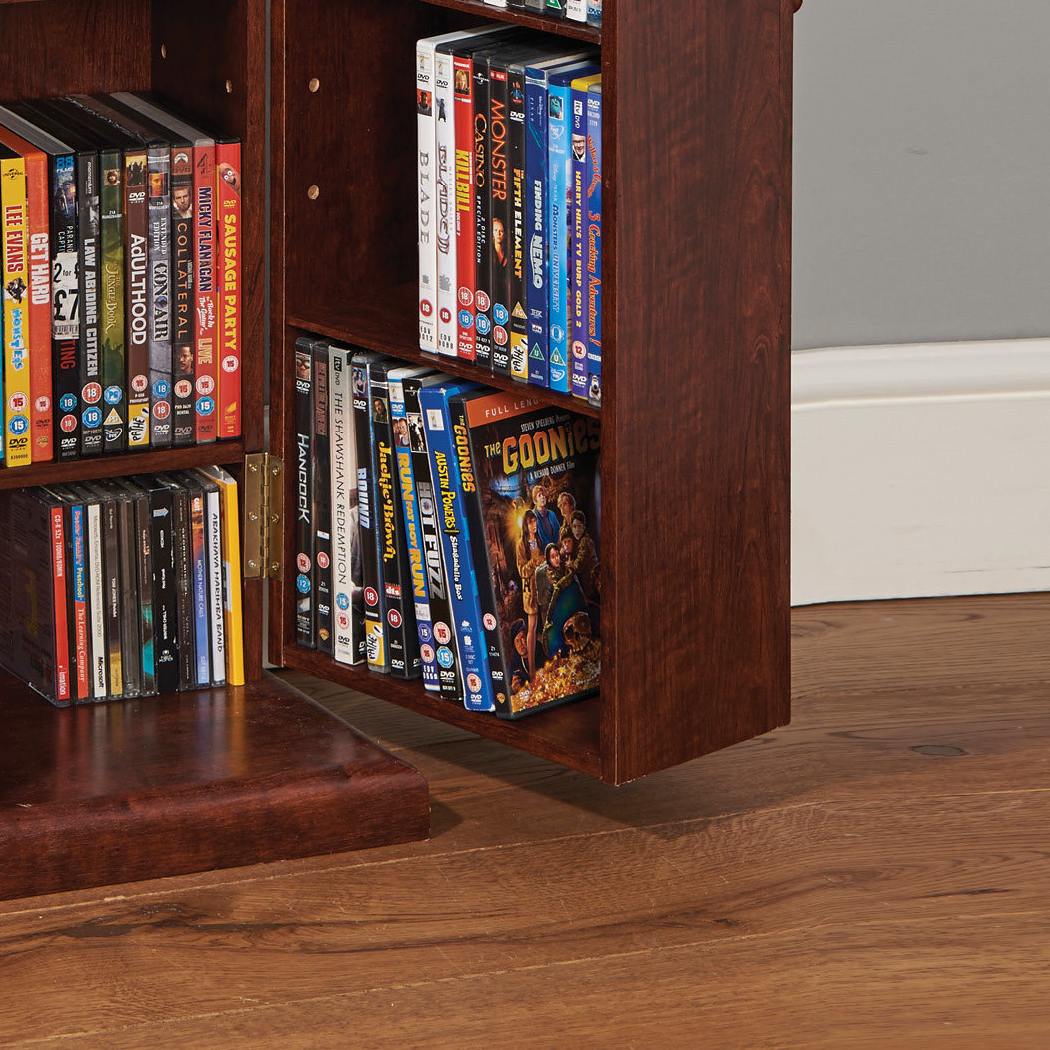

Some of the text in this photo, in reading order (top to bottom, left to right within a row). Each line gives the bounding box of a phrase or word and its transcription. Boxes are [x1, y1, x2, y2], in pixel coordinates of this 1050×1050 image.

[56, 156, 74, 168] 88
[456, 149, 471, 213] KILL BILL
[474, 113, 487, 189] CASINO
[491, 98, 507, 201] MONSTER
[419, 151, 430, 245] BLADE
[513, 168, 522, 279] FIFTH ELEMENT
[588, 210, 601, 222] 3
[5, 205, 24, 274] LEE EVANS
[198, 187, 212, 293] MICKY FLANAGAN
[533, 180, 543, 289] FINDING NEMO
[552, 202, 560, 313] MONSTERS UNIVERSITY
[575, 241, 582, 257] TV
[587, 223, 602, 277] Cracking
[30, 232, 50, 305] GET HARD
[54, 262, 71, 284] 2 for
[153, 262, 169, 341] CON AIR
[177, 222, 188, 339] COLLATERAL
[224, 214, 238, 351] SAUSAGE PARTY
[574, 259, 582, 287] BURP
[53, 289, 79, 321] £7
[84, 238, 99, 378] LAW ABIDING CITIZEN
[574, 289, 582, 318] GOLD
[198, 337, 213, 365] LIVE
[484, 407, 510, 418] FULL
[520, 415, 555, 434] STEVEN SPIELBERG
[297, 432, 311, 525] HANCOCK
[334, 392, 347, 585] THE SHAWSHANK REDEMPTION
[357, 467, 371, 529] BOUND
[378, 440, 394, 496] Jackie
[434, 450, 457, 533] AUSTIN POWERS
[534, 464, 566, 480] RICHARD DONNER
[397, 452, 427, 598] RUN RUN
[76, 567, 84, 598] Preschool
[214, 571, 222, 621] MARIMBA
[425, 534, 447, 600] FUZZ
[77, 609, 86, 682] The Learning Company
[215, 624, 223, 653] BAND
